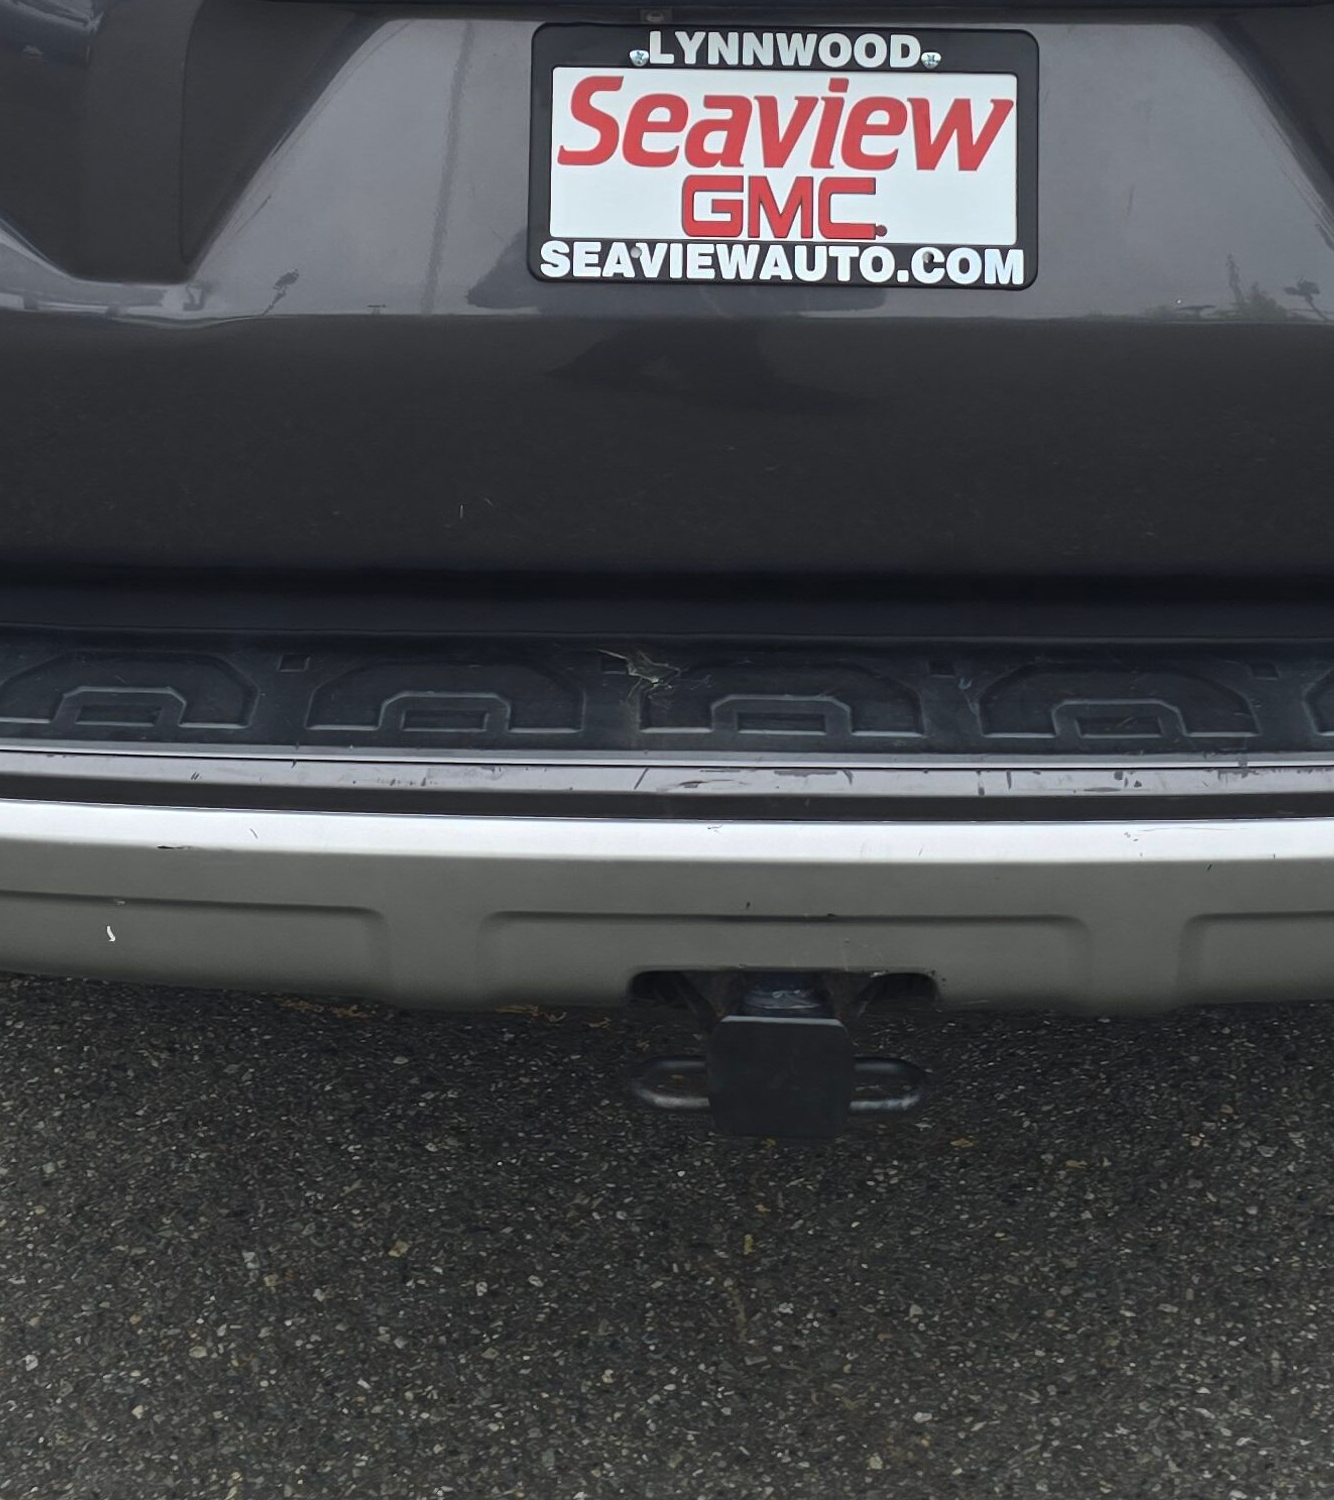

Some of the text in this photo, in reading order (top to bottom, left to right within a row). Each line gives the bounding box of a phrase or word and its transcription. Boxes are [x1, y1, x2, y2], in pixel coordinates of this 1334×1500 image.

[648, 30, 922, 69] LYNNWOOD
[557, 75, 1015, 172] Seaview
[680, 173, 879, 241] GMC
[540, 240, 1025, 285] SEAVIEWAUTO.COM
